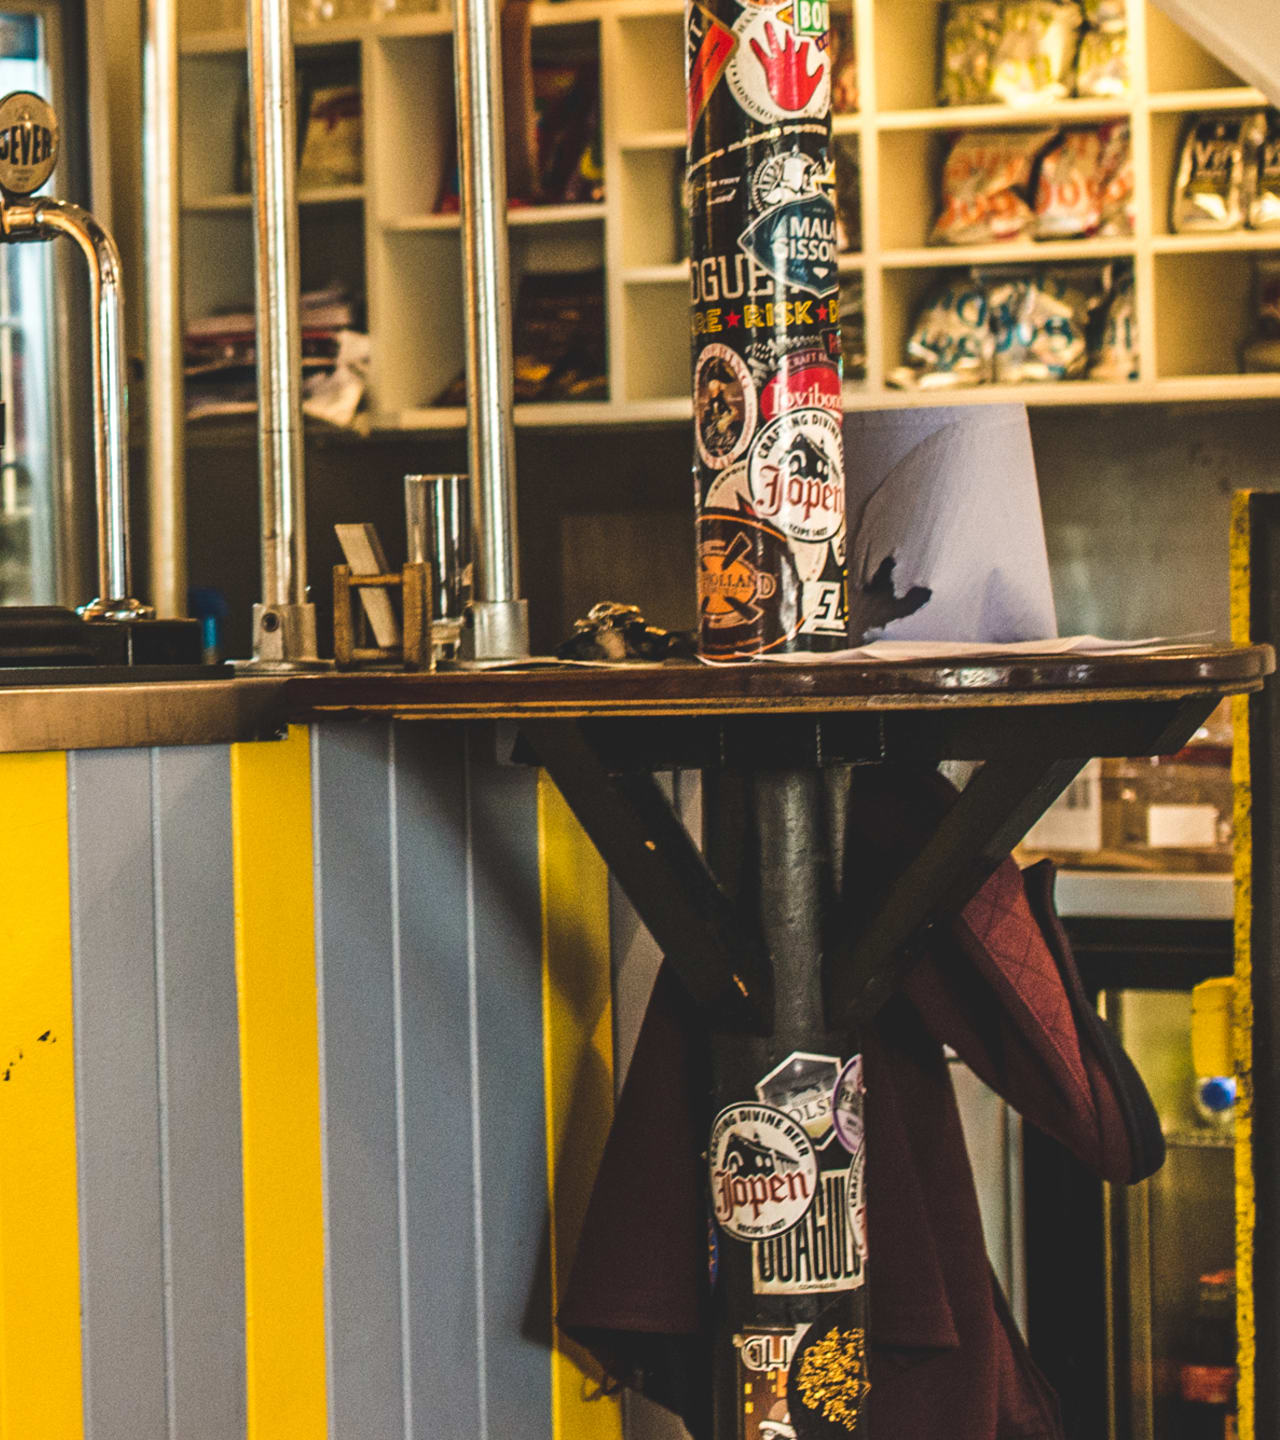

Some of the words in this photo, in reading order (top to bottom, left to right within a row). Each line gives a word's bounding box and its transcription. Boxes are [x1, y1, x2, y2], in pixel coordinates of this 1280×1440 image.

[690, 253, 775, 305] OGUE
[743, 300, 814, 329] RISK
[739, 1110, 783, 1130] DIVINE
[784, 1126, 810, 1158] BEER
[714, 1170, 811, 1223] Jopen
